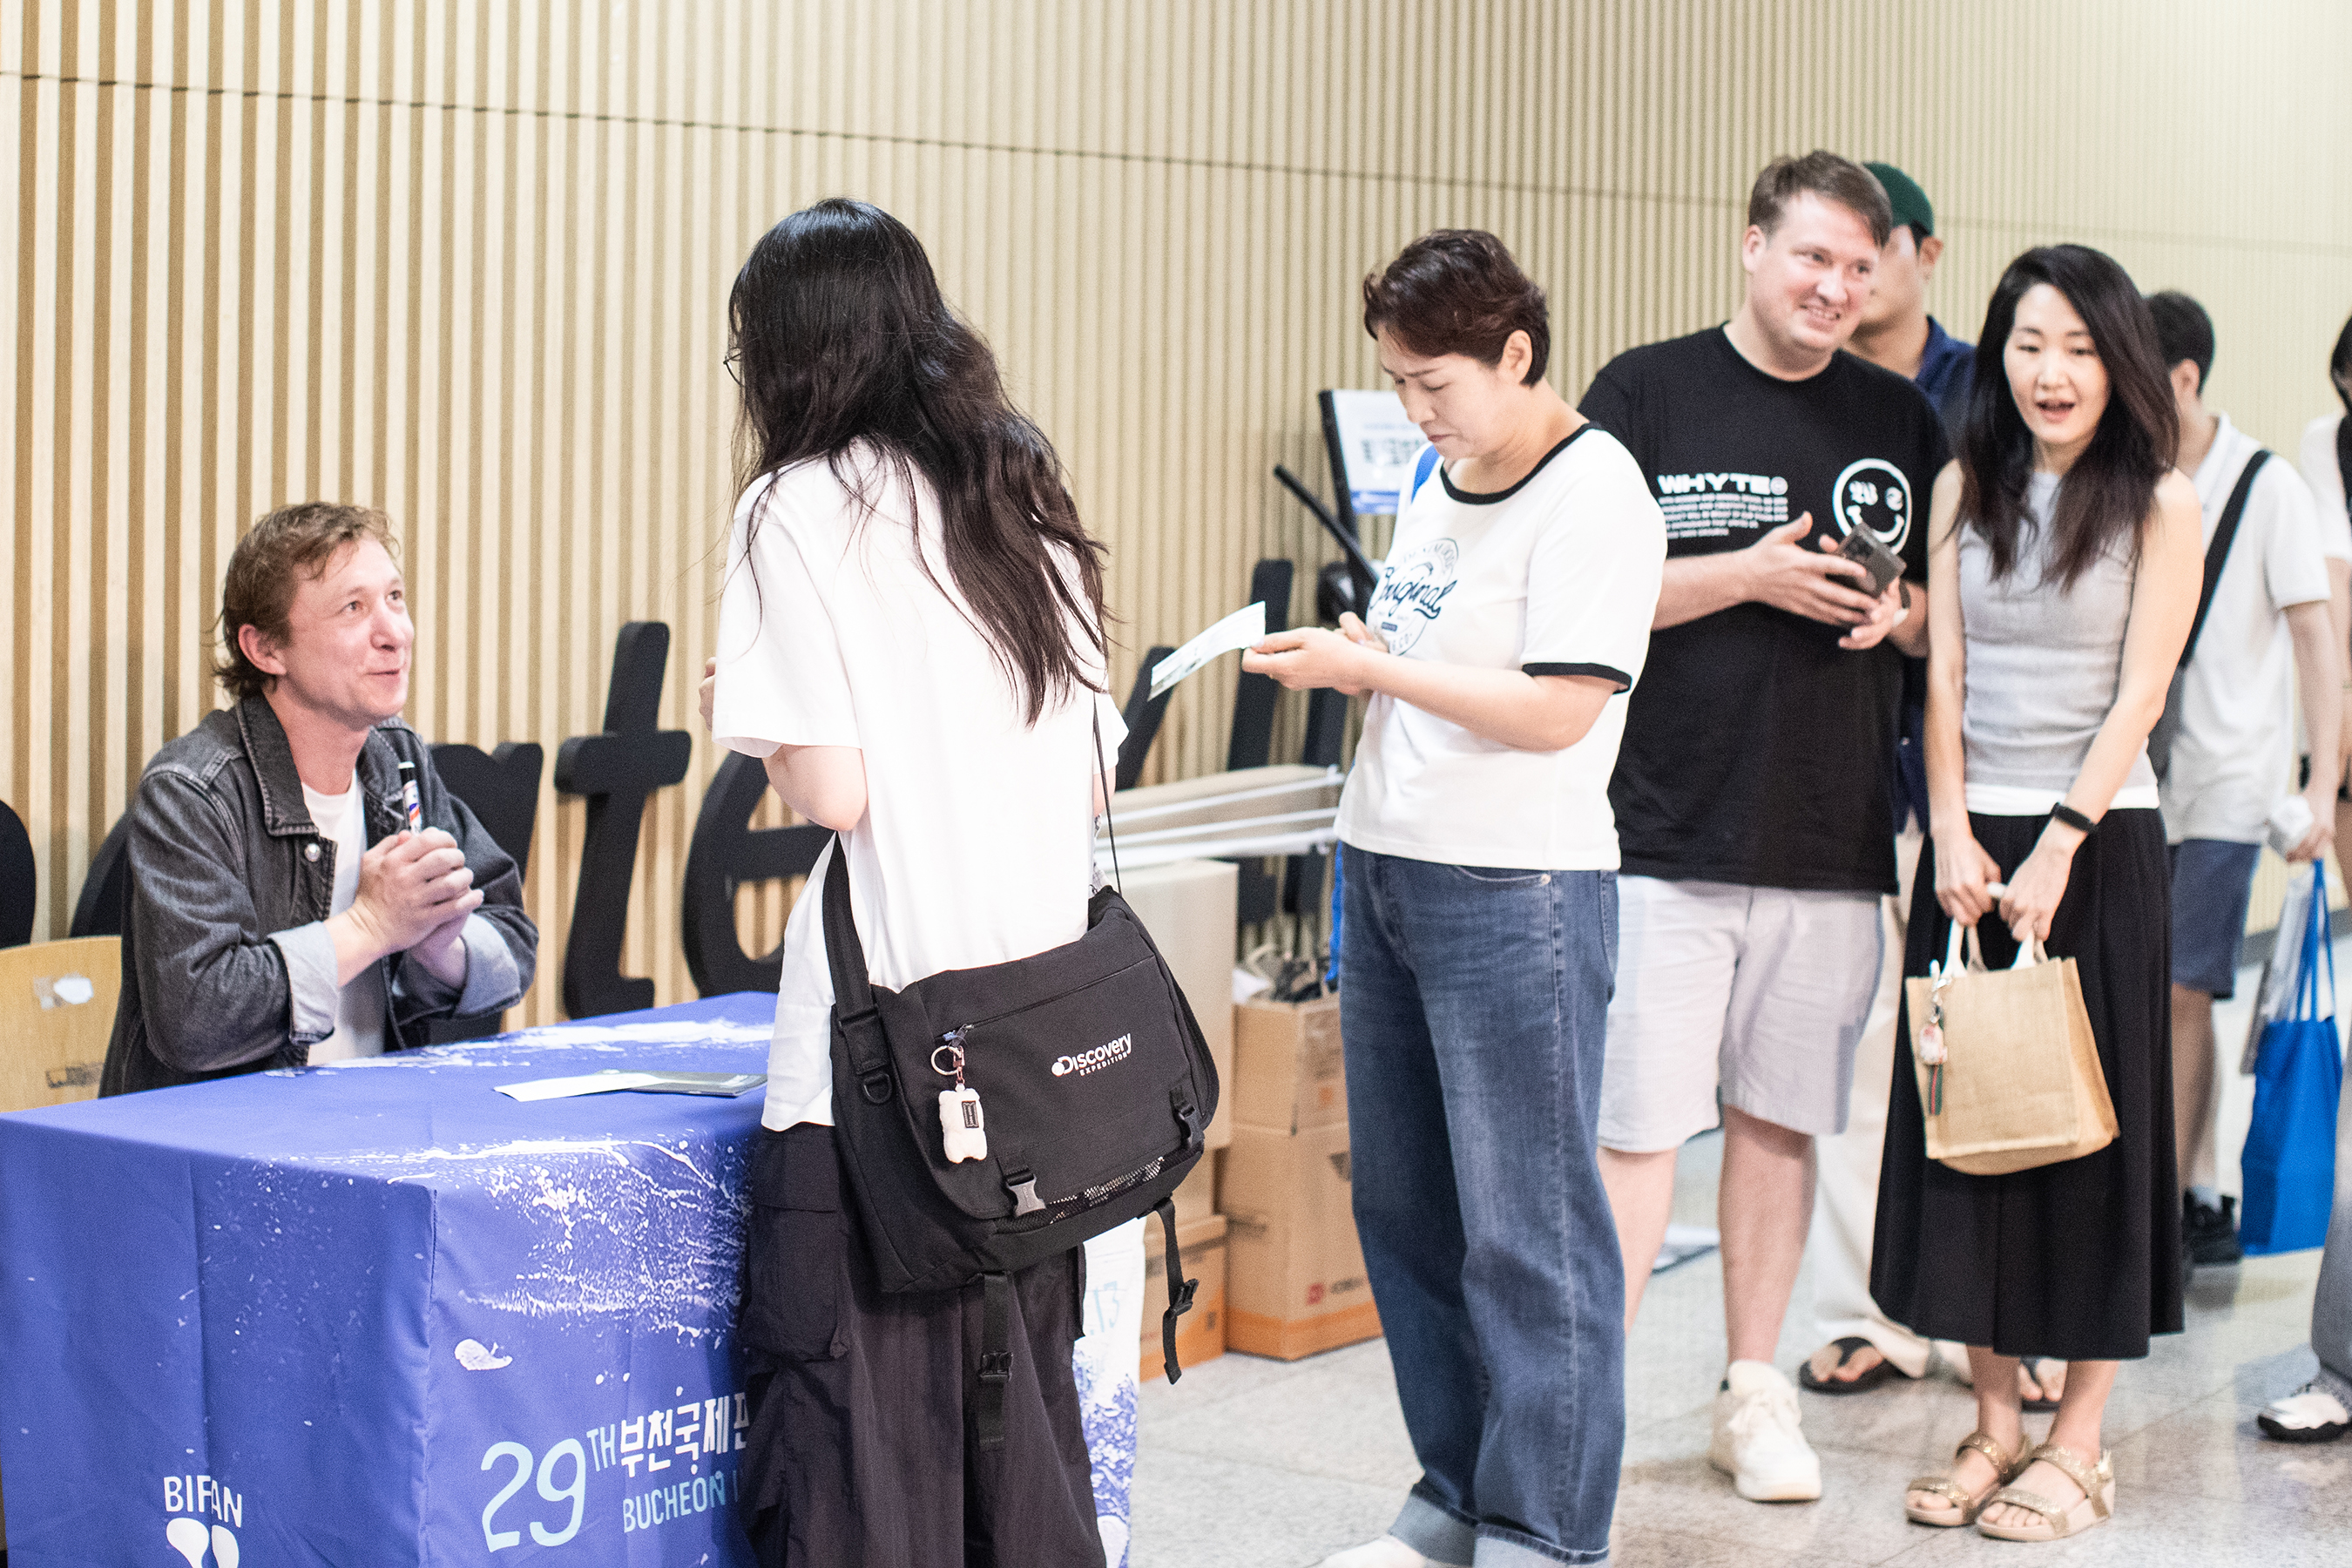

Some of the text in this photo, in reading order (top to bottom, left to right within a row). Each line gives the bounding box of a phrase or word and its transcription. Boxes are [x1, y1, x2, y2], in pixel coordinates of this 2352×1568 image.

[1080, 1051, 1127, 1077] EXPEDITION
[163, 1475, 242, 1528] BIFAN
[623, 1470, 726, 1533] BUCHEON
